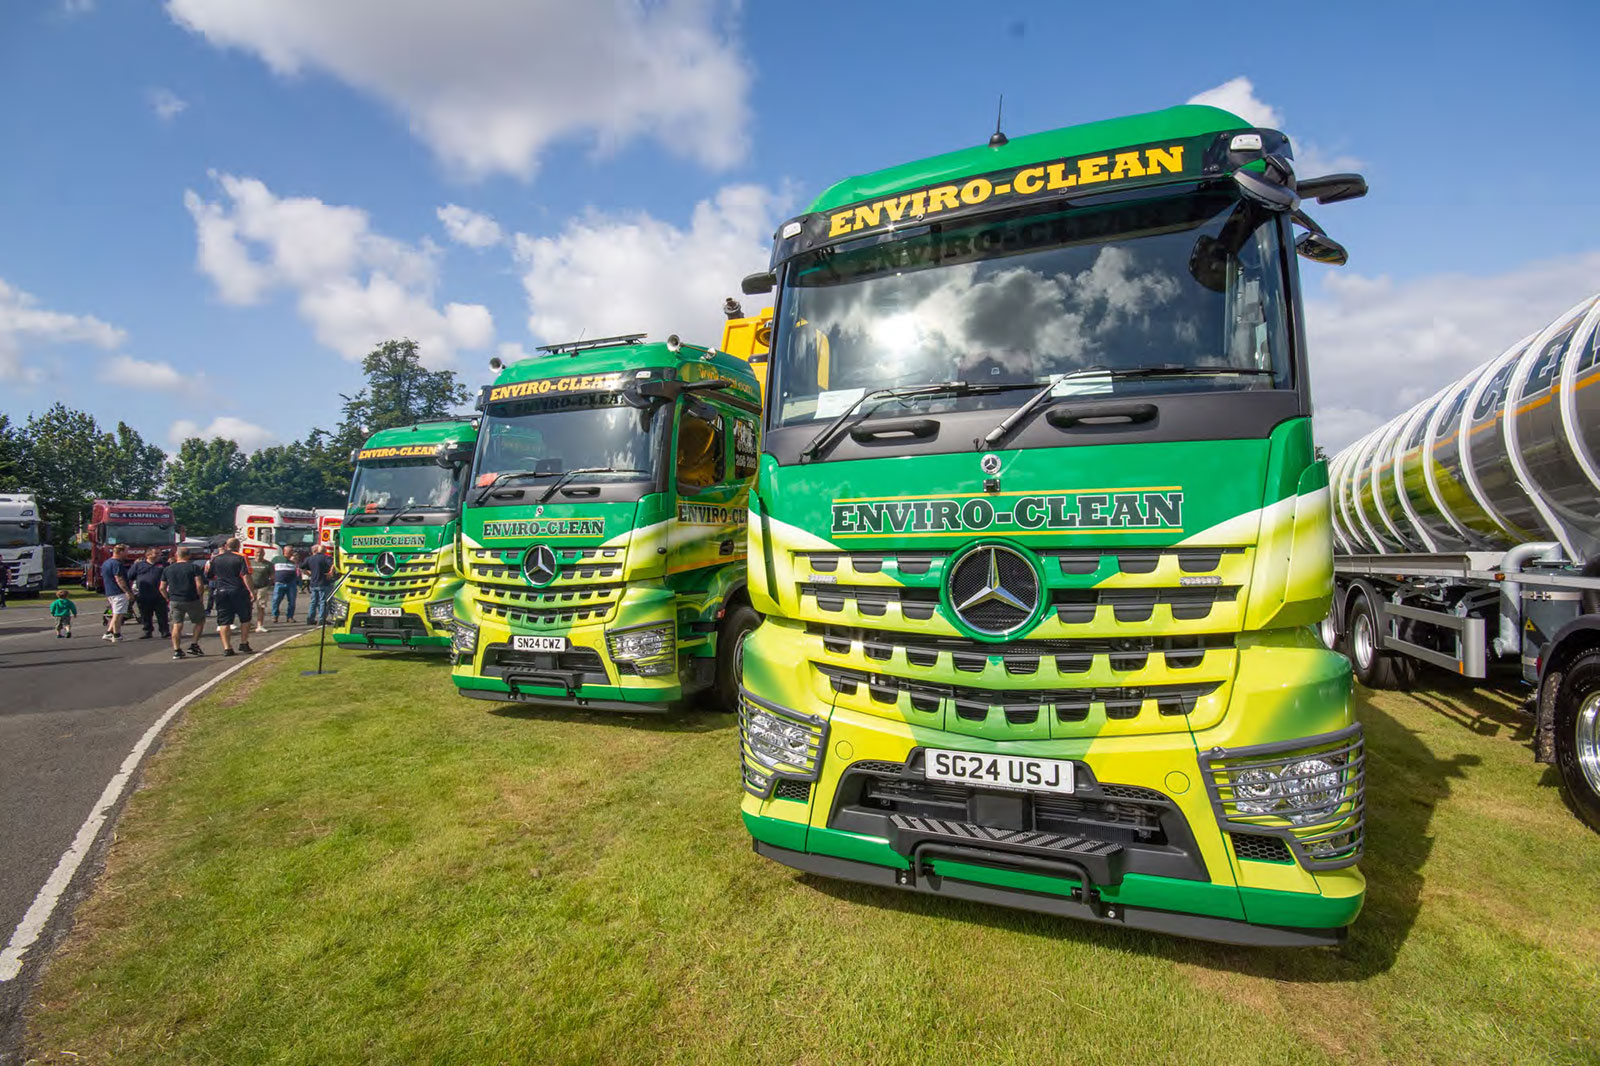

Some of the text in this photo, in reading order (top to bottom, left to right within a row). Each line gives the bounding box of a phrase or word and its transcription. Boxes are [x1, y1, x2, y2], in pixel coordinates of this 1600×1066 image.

[828, 145, 1184, 238] ENVIRO-CLEAN
[358, 446, 438, 460] ENVIRO-CLEAN
[831, 492, 1184, 533] ENVIRO-CLEAN
[483, 520, 605, 537] ENVIRO-CLEAN
[352, 535, 425, 546] ENVIRO-CLEAN
[372, 608, 387, 616] SN23
[517, 637, 561, 650] SN24 CWZ
[935, 753, 1060, 787] SG24 USJ
